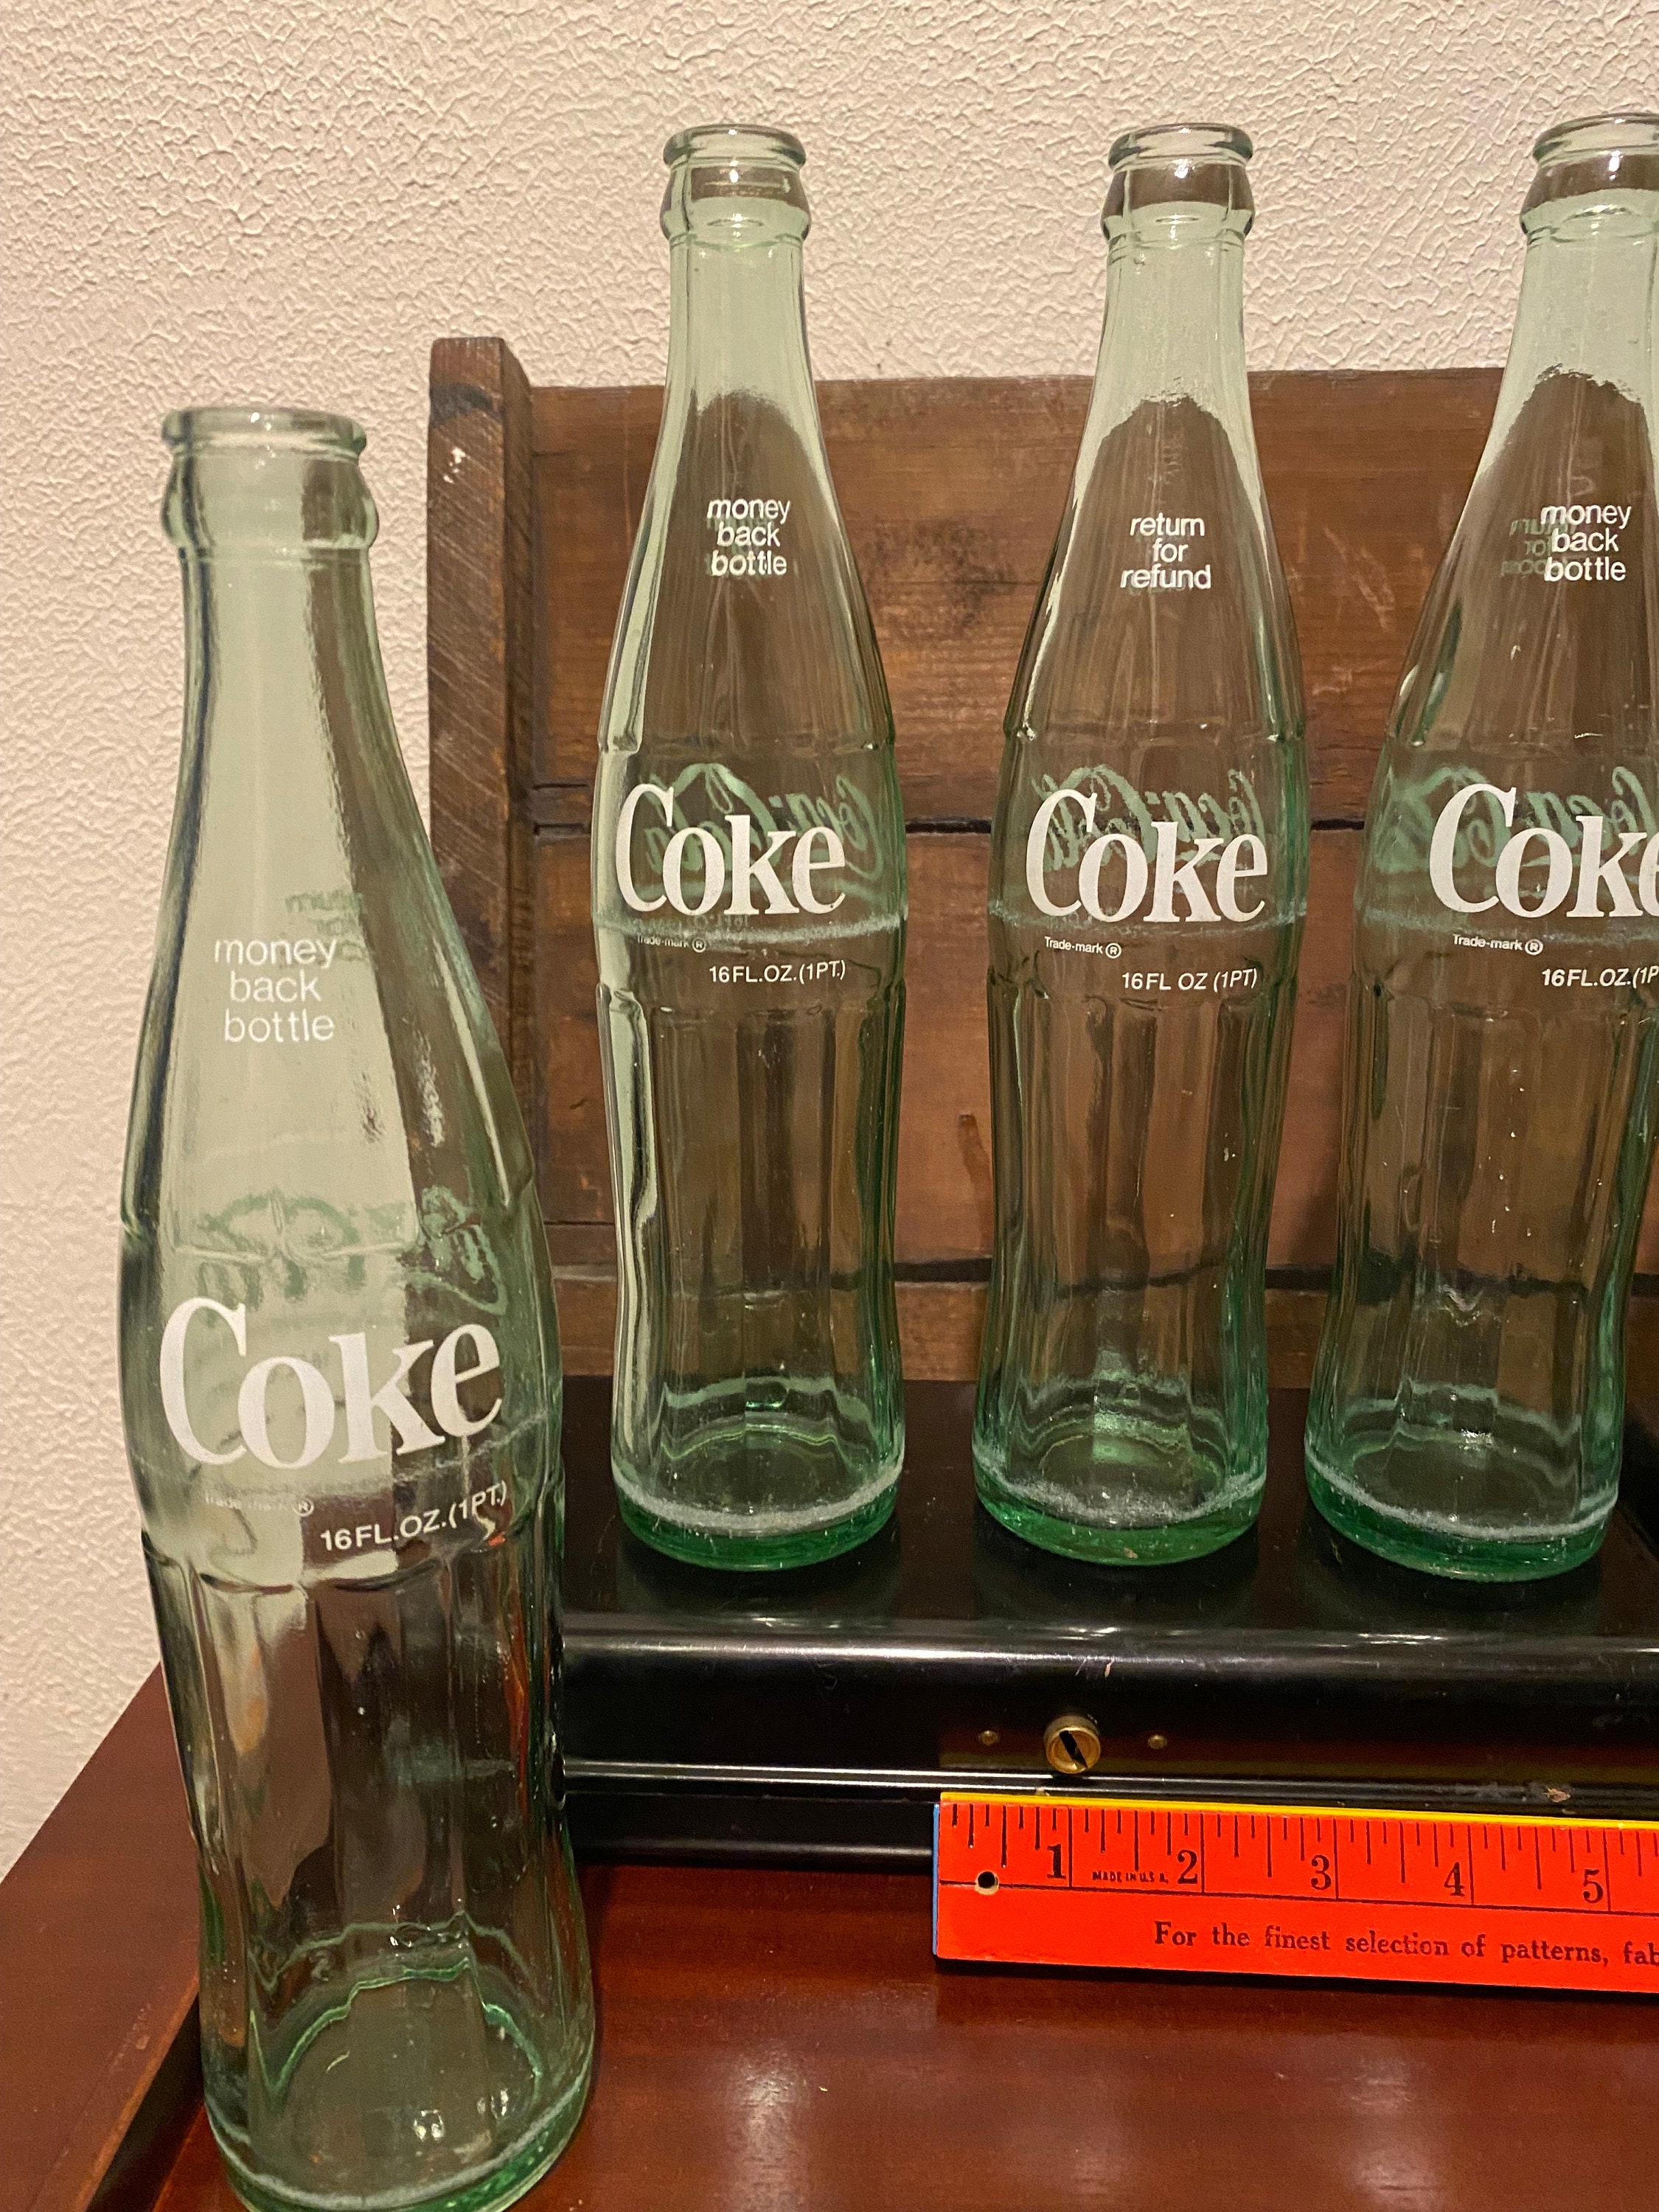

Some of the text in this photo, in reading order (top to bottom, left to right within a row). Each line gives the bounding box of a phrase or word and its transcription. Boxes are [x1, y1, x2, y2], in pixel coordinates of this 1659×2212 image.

[707, 498, 790, 524] money
[1130, 512, 1205, 536] return
[1540, 504, 1632, 529] money
[717, 521, 780, 546] back
[1551, 527, 1619, 552] back
[712, 549, 787, 576] bottle
[1152, 537, 1189, 563] for
[1120, 563, 1211, 590] refund
[1544, 556, 1627, 582] bottle
[615, 783, 846, 916] Coke
[1026, 789, 1267, 922] Coke
[214, 937, 337, 970] money
[229, 968, 322, 1004] back
[223, 1007, 335, 1043] bottle
[159, 1295, 503, 1472] Coke
[1047, 1843, 1604, 1904] 1 2 3 4 5
[1092, 1870, 1122, 1883] MADE
[1125, 1872, 1137, 1882] IN
[1155, 1921, 1197, 1947] For
[1212, 1922, 1250, 1947] the
[1265, 1924, 1331, 1950] finest
[1346, 1929, 1449, 1956] selection
[1461, 1933, 1486, 1958] of
[1500, 1939, 1609, 1967] patterns,
